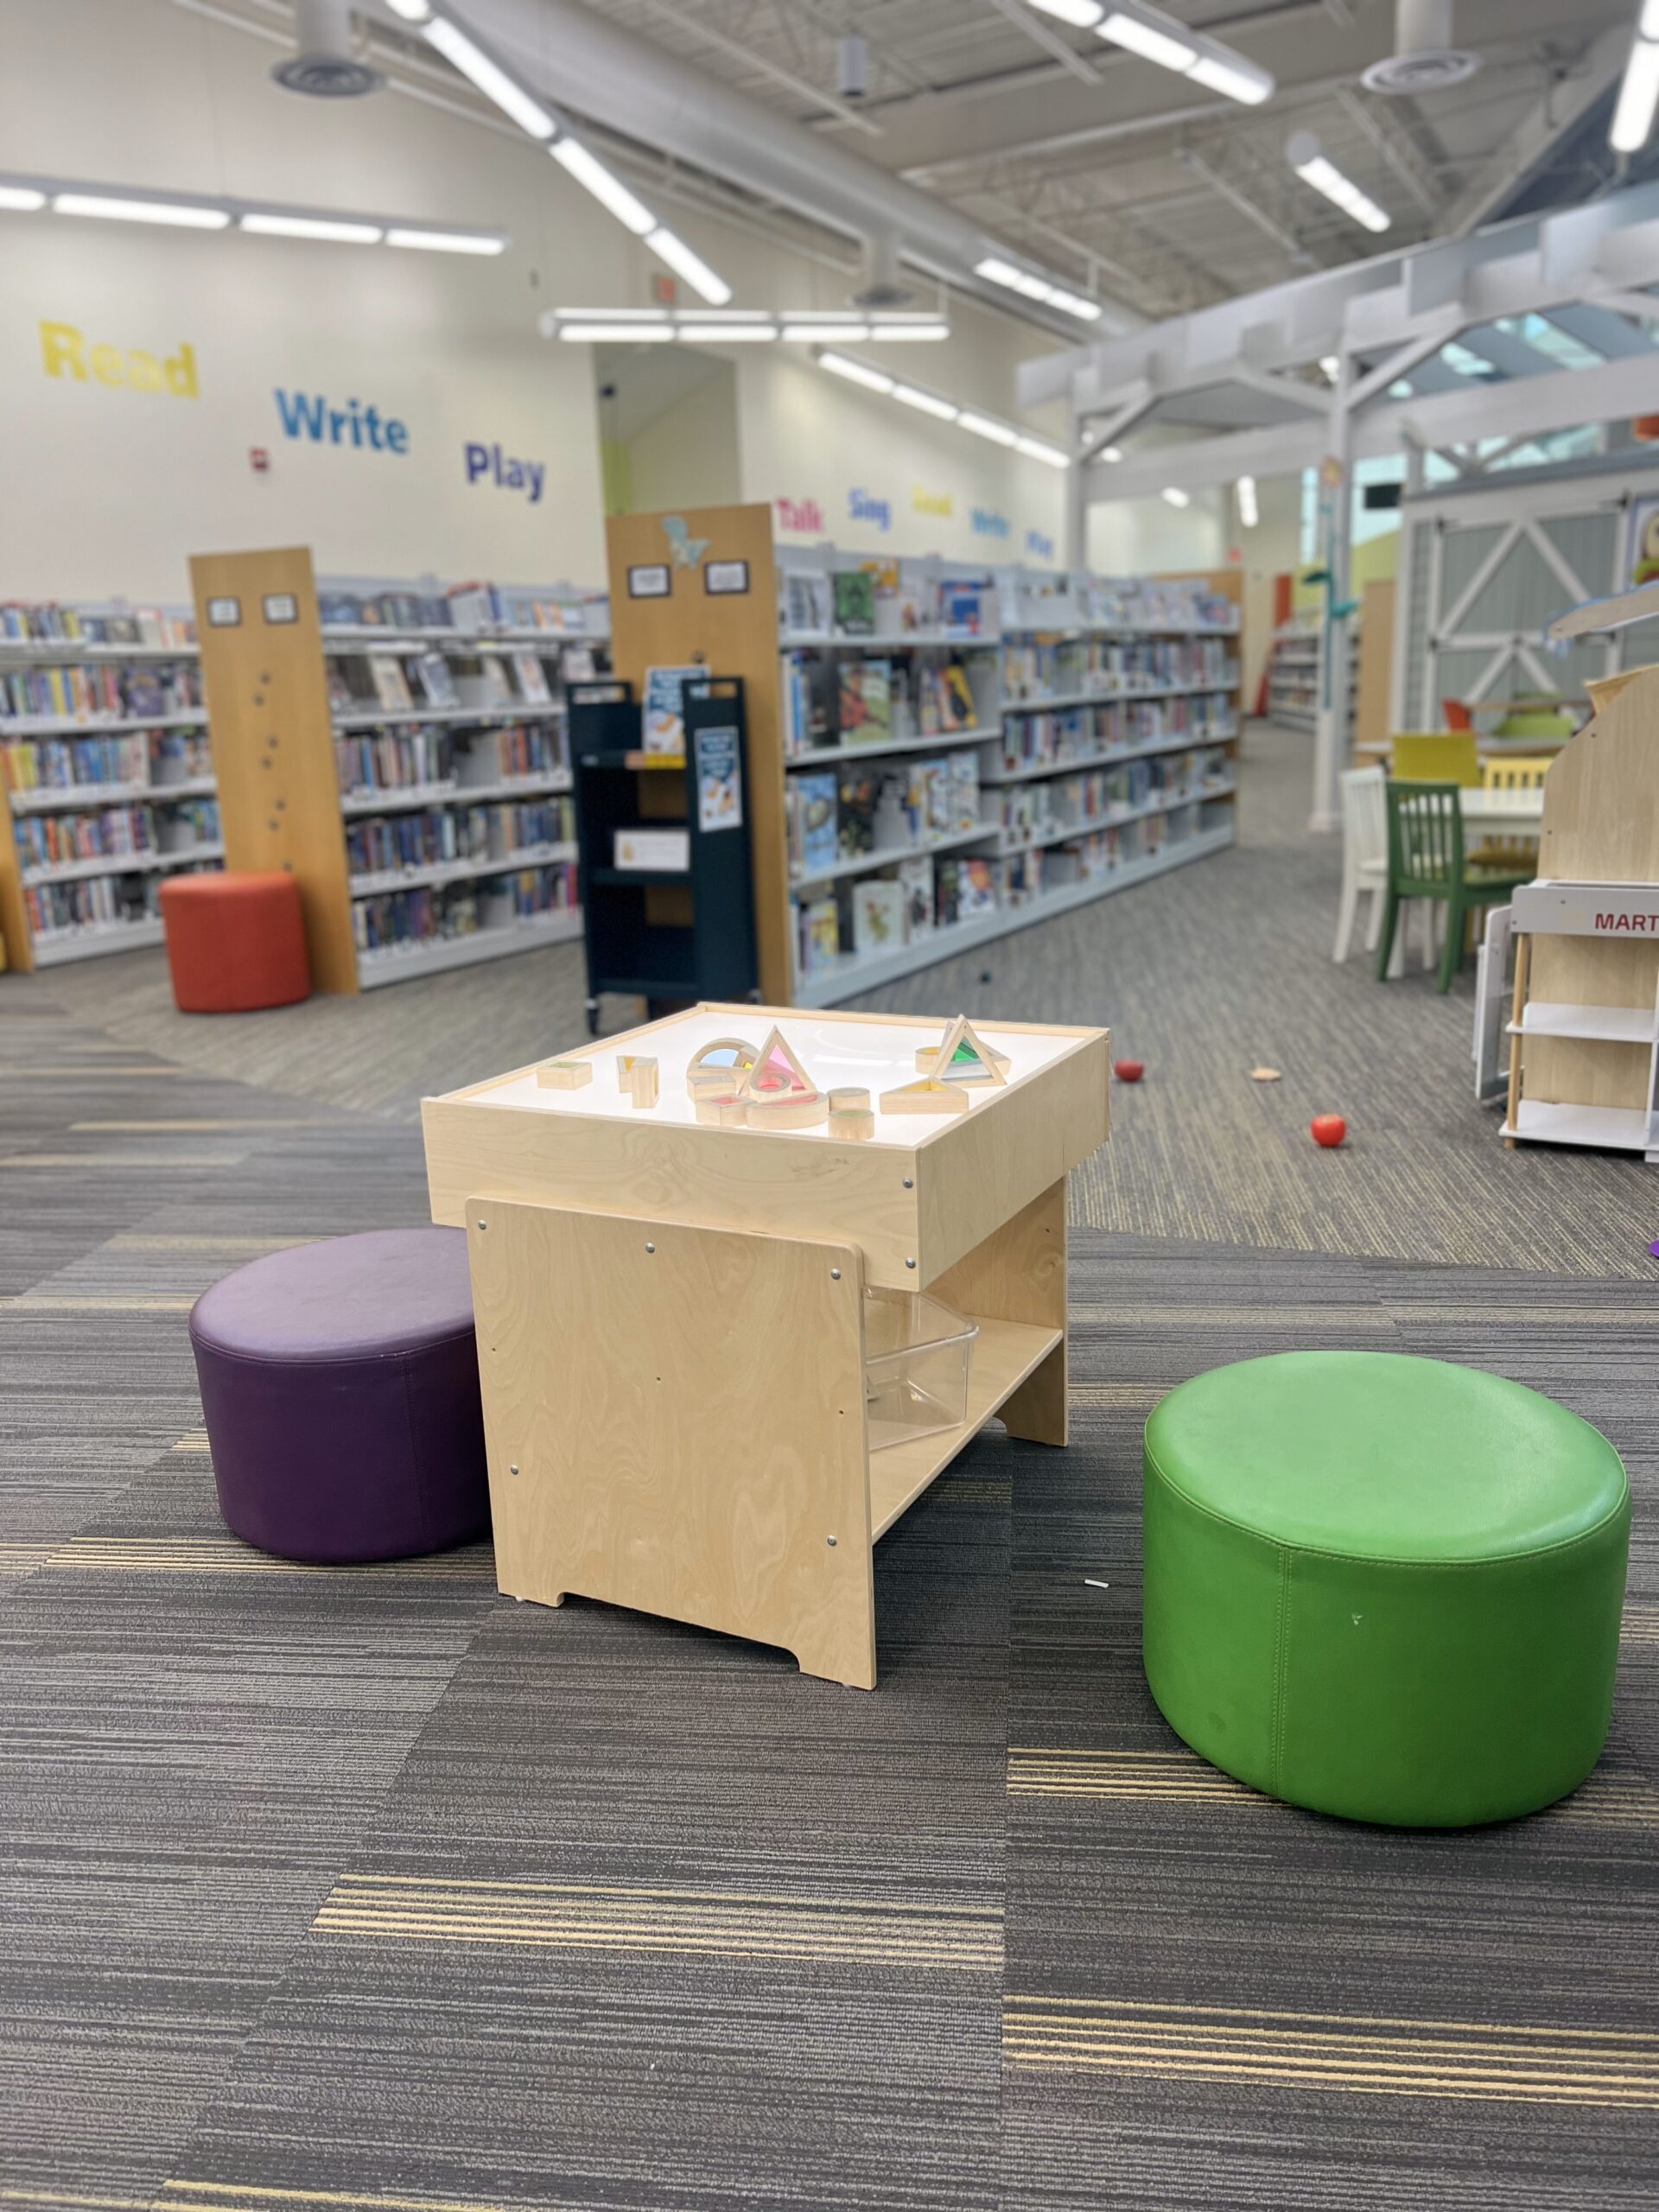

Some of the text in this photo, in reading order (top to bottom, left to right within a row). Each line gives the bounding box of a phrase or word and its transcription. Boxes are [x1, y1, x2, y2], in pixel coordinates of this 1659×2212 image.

[39, 319, 200, 398] Read
[275, 389, 408, 454] Write
[464, 442, 544, 503] Play
[775, 498, 823, 532] Talk
[849, 488, 890, 531] Sing
[1595, 913, 1659, 931] MART
